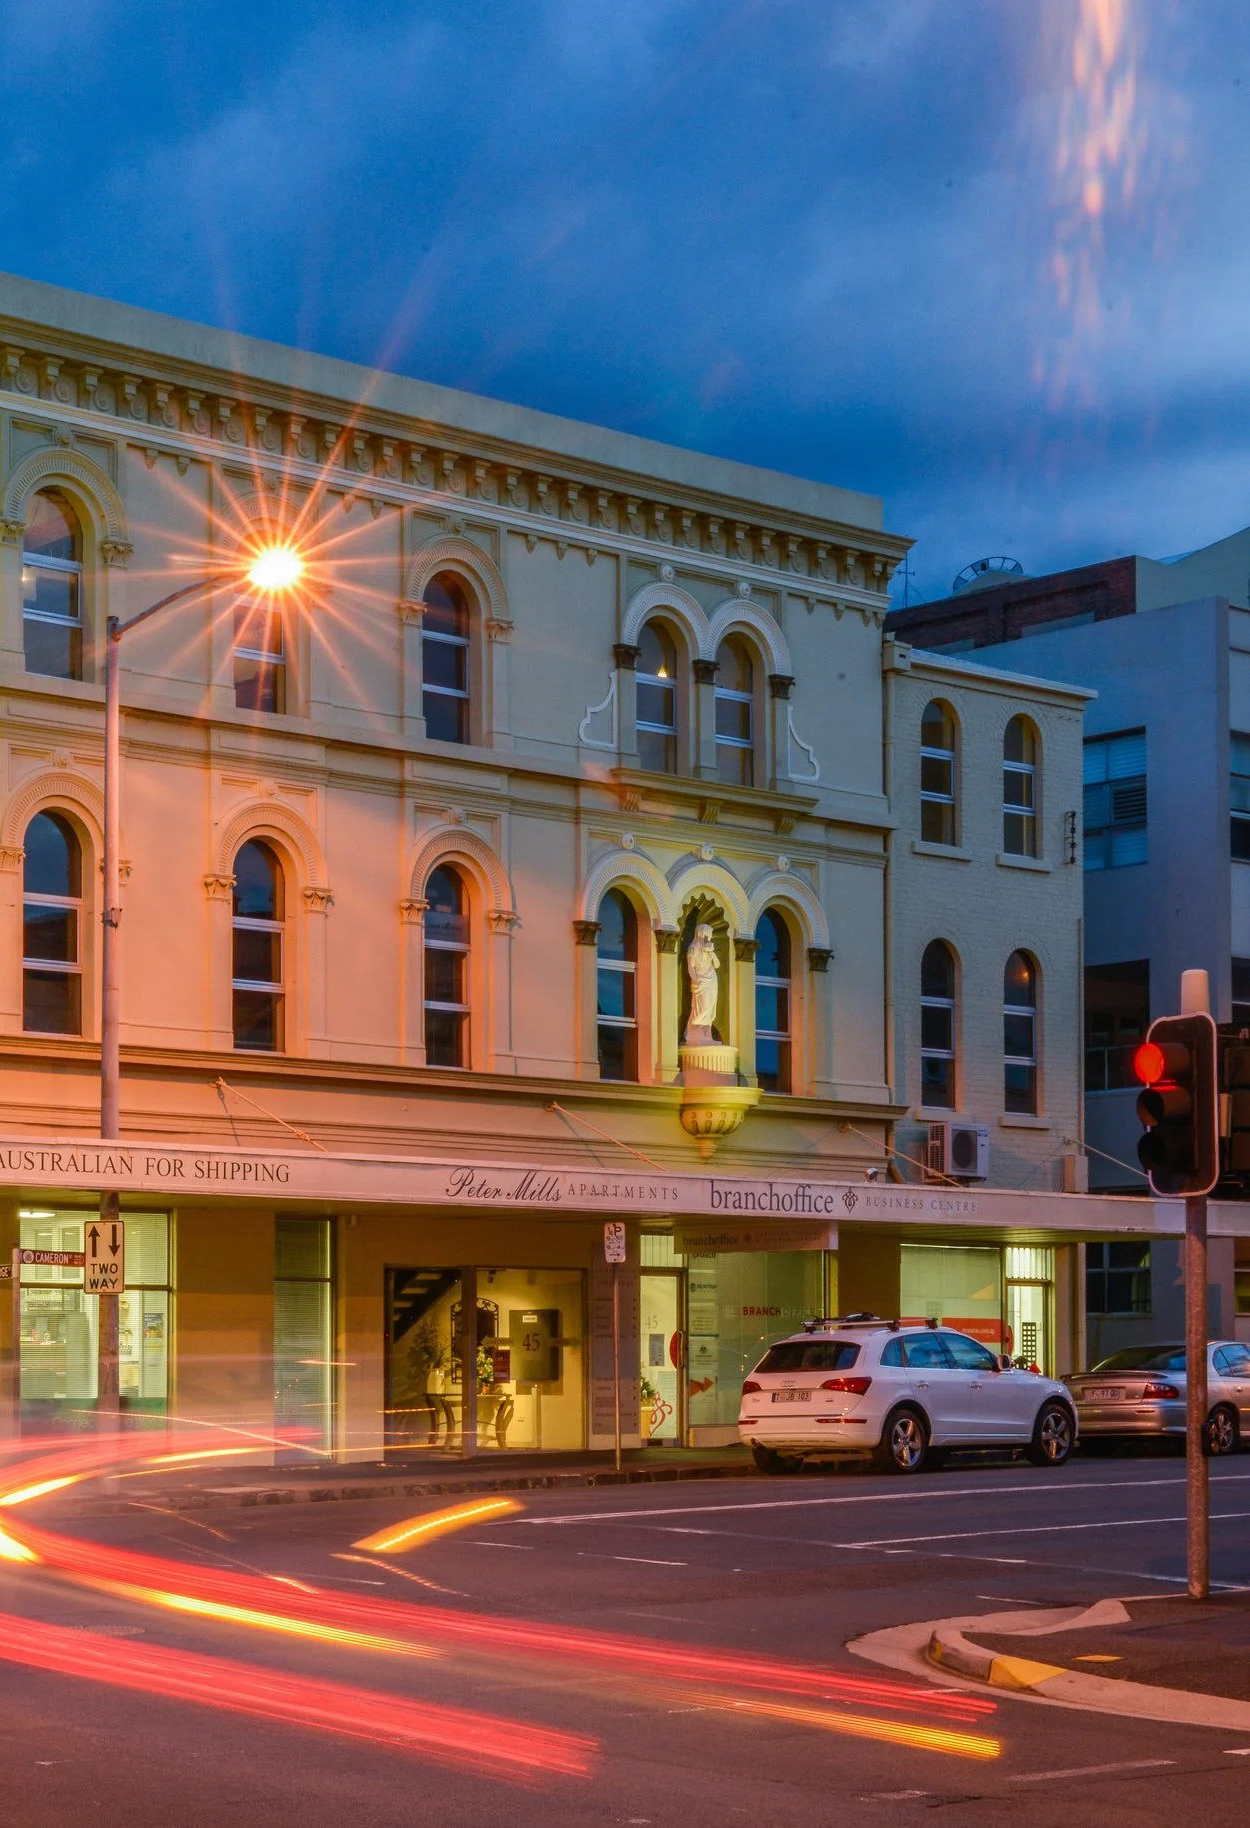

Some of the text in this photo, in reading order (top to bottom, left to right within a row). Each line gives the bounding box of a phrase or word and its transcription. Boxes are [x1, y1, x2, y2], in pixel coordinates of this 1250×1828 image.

[144, 1157, 186, 1178] FOR
[194, 1159, 290, 1183] SHIPPING
[445, 1165, 679, 1202] Peter Mills APARTMENTS
[710, 1179, 834, 1213] branchoffice
[865, 1196, 977, 1212] BUSINESS CENTRE
[682, 1234, 740, 1246] branchoffice
[35, 1252, 69, 1265] CAMERON
[90, 1263, 119, 1275] TWO
[89, 1278, 119, 1289] WAY
[743, 1306, 781, 1316] BRANCH
[521, 1332, 541, 1352] 45
